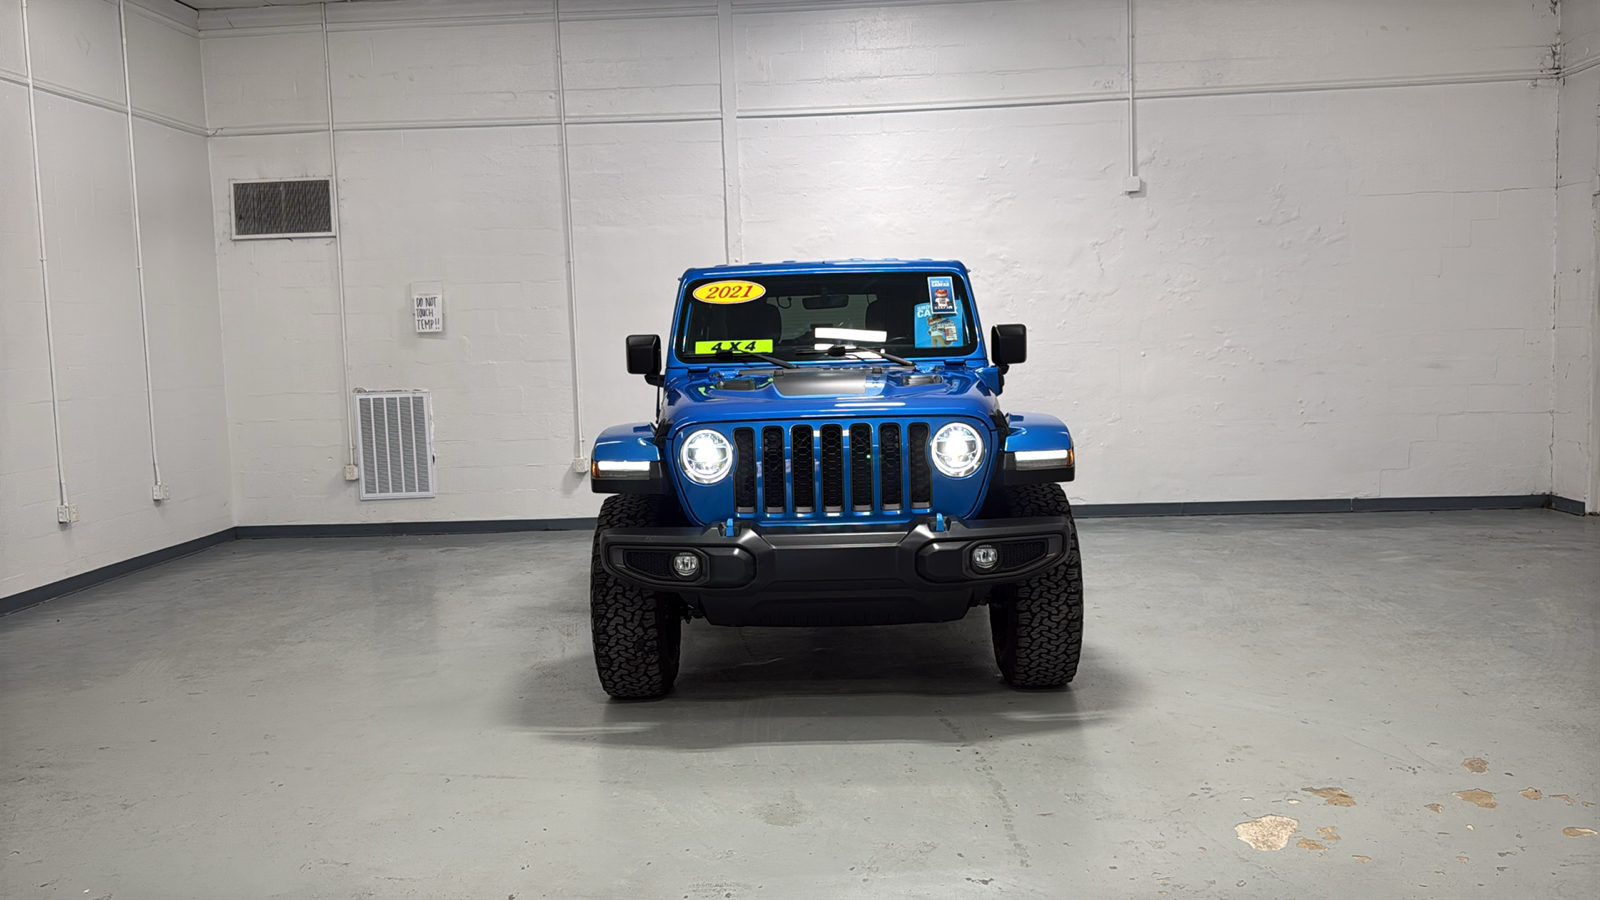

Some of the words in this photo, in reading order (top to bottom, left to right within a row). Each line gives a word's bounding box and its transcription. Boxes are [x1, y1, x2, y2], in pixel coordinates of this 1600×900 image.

[705, 285, 754, 299] 2021
[416, 297, 423, 307] DO
[425, 296, 438, 307] NOT
[416, 308, 434, 318] TOUCH
[416, 318, 440, 330] TEMP!!
